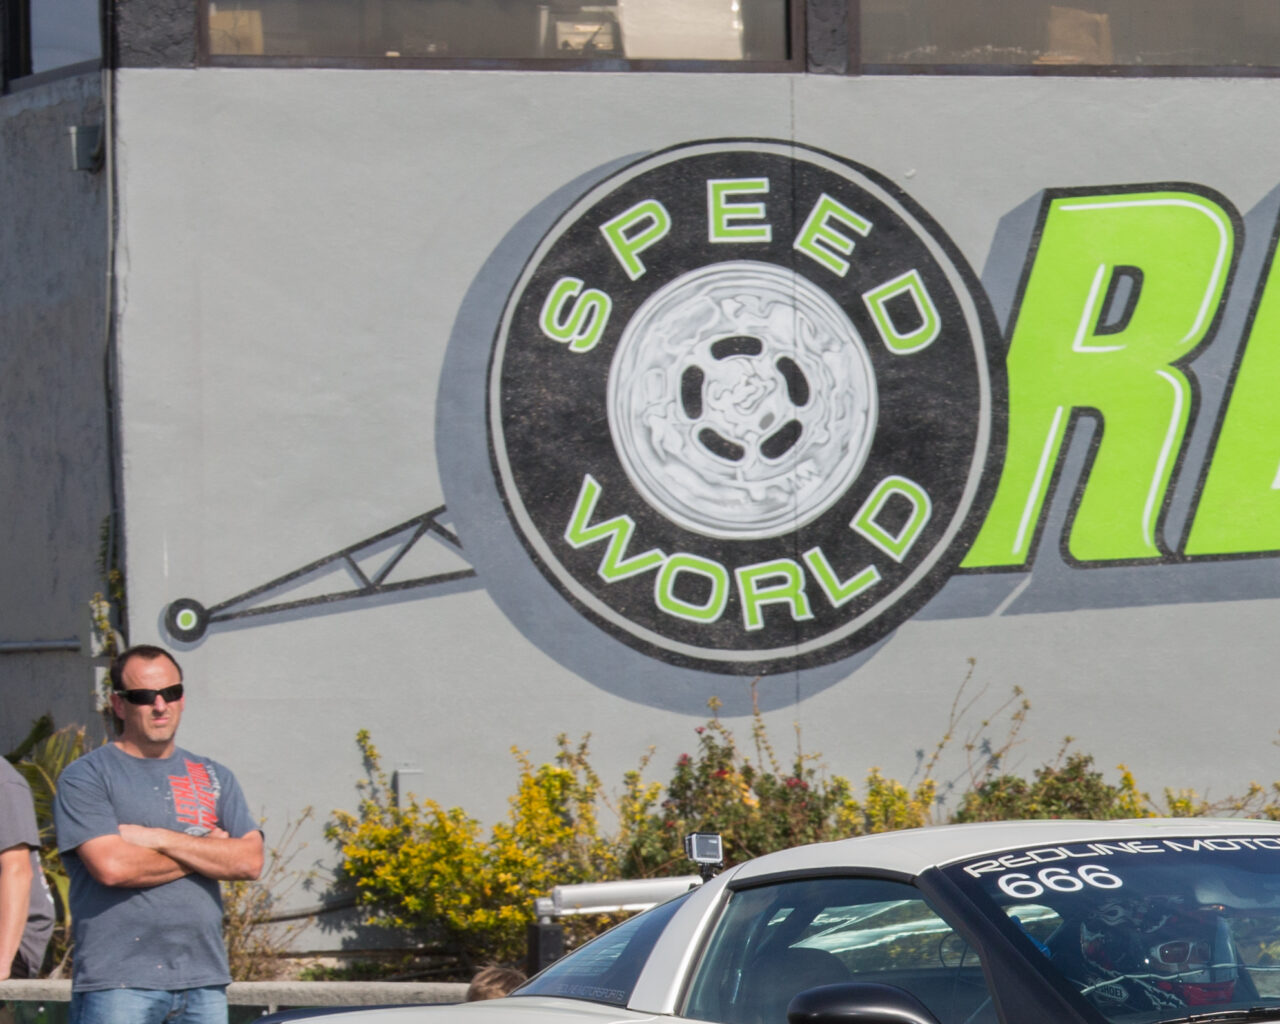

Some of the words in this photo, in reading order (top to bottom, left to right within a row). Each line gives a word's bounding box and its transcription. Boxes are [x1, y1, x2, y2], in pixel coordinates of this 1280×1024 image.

[539, 177, 941, 355] SPEED
[564, 473, 932, 631] WORLD
[167, 774, 200, 825] LETHAL
[963, 841, 1165, 877] REDLINE
[998, 864, 1123, 898] 666
